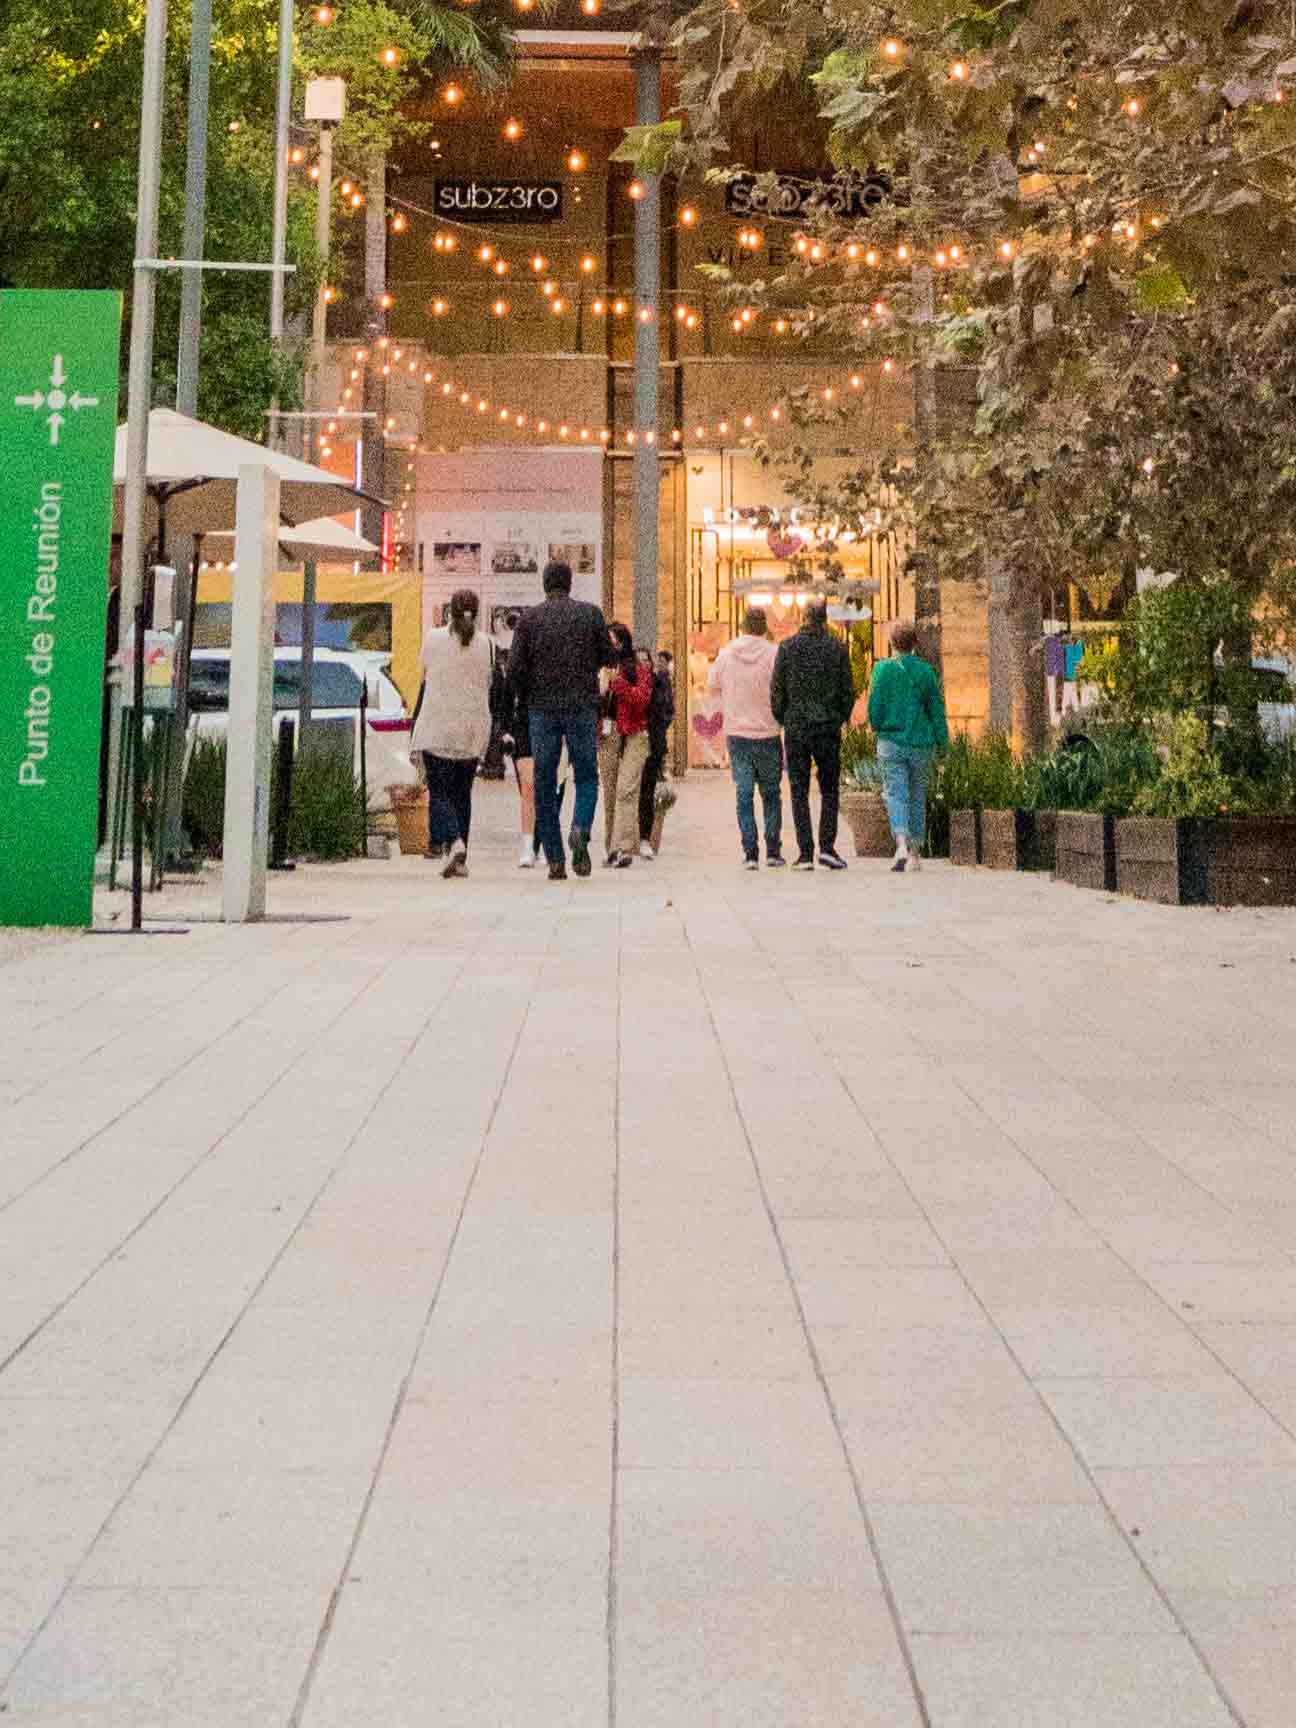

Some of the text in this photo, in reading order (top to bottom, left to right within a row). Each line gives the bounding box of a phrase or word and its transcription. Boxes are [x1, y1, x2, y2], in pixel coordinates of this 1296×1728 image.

[439, 182, 559, 209] subz3ro
[17, 481, 63, 786] Punto de Reunión
